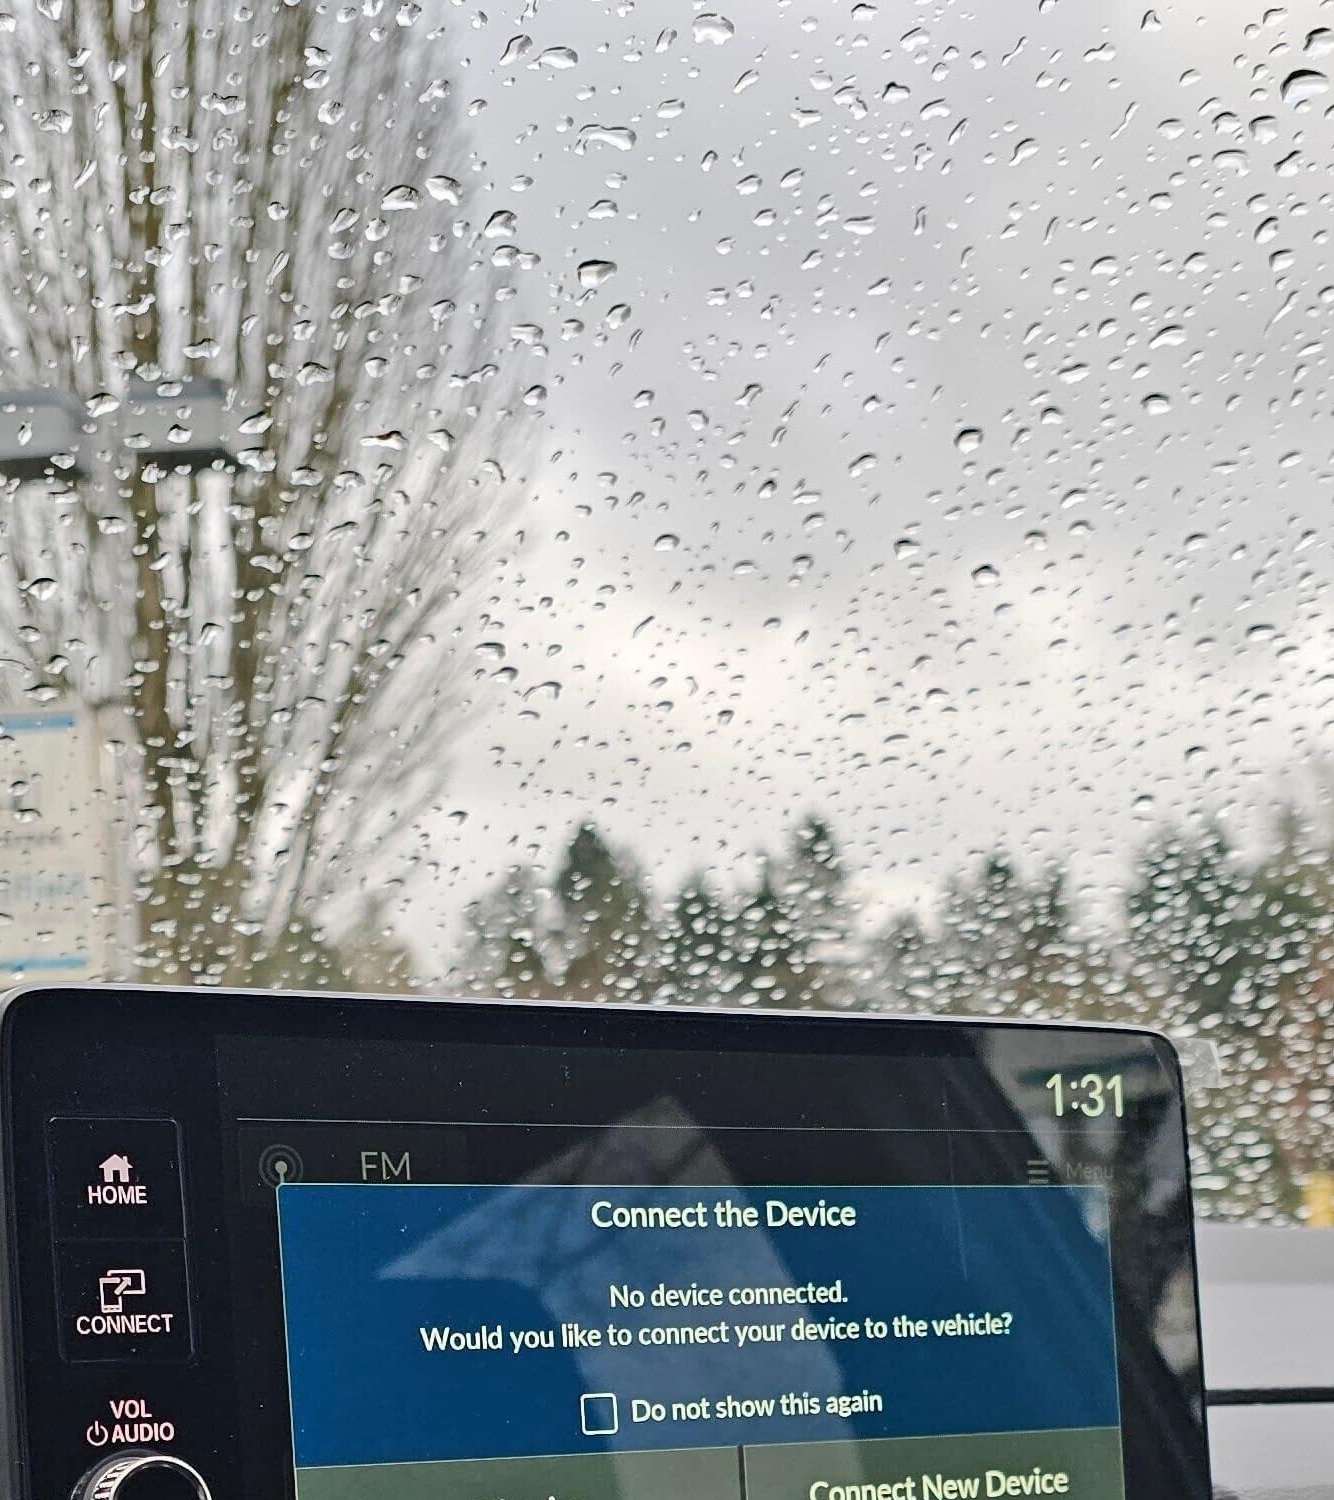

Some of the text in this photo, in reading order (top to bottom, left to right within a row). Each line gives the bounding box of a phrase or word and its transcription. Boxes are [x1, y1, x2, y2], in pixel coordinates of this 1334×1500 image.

[1044, 1074, 1125, 1118] 1:31
[360, 1151, 412, 1182] FM
[87, 1185, 148, 1205] HOME
[591, 1199, 857, 1230] Connect the Device
[609, 1280, 849, 1308] No device connected.
[75, 1313, 174, 1335] CONNECT
[420, 1312, 1014, 1354] Would you like to connect your device to the vehicle?
[108, 1399, 153, 1419] VOL
[631, 1390, 884, 1423] Do not show this again
[111, 1421, 176, 1443] AUDIO
[986, 1466, 1070, 1498] Device
